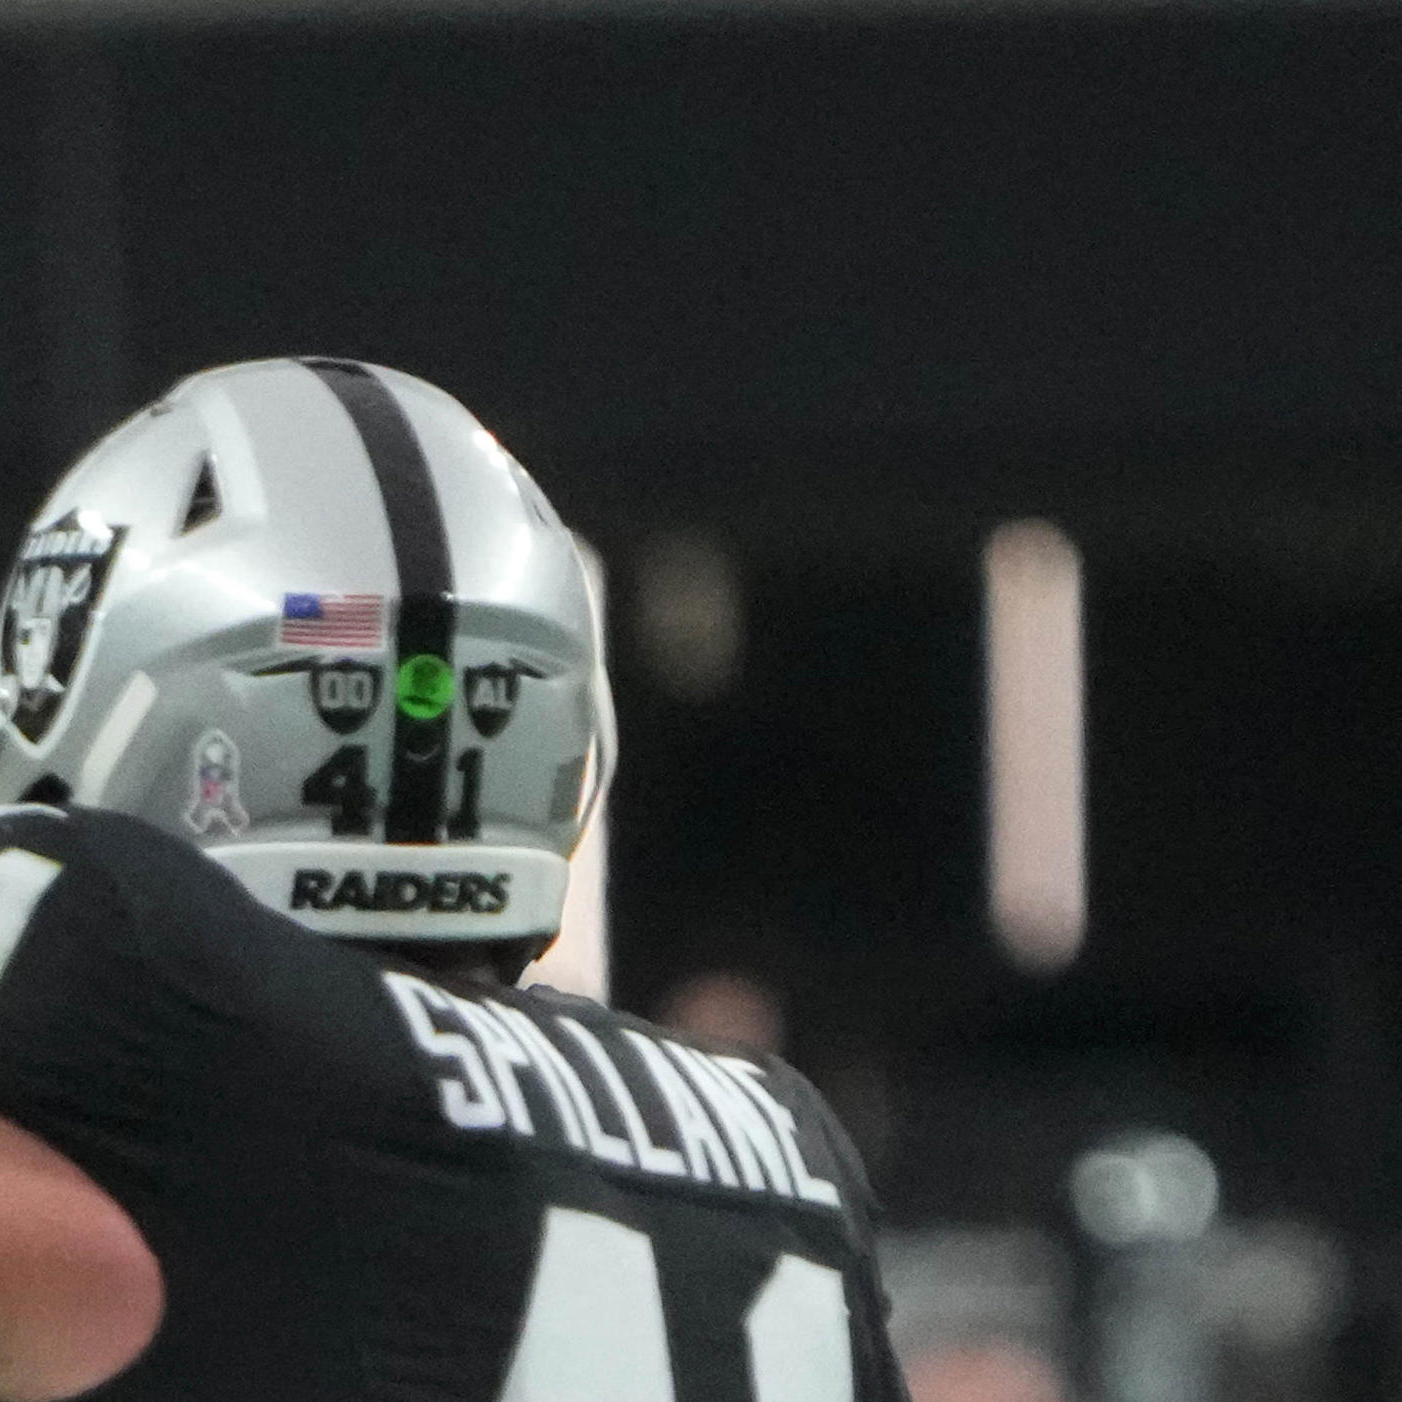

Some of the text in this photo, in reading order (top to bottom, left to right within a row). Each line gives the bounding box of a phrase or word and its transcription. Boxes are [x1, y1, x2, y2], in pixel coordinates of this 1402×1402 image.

[300, 744, 485, 840] 41
[292, 868, 511, 913] RAIDERS
[382, 970, 842, 1208] SPILLANE
